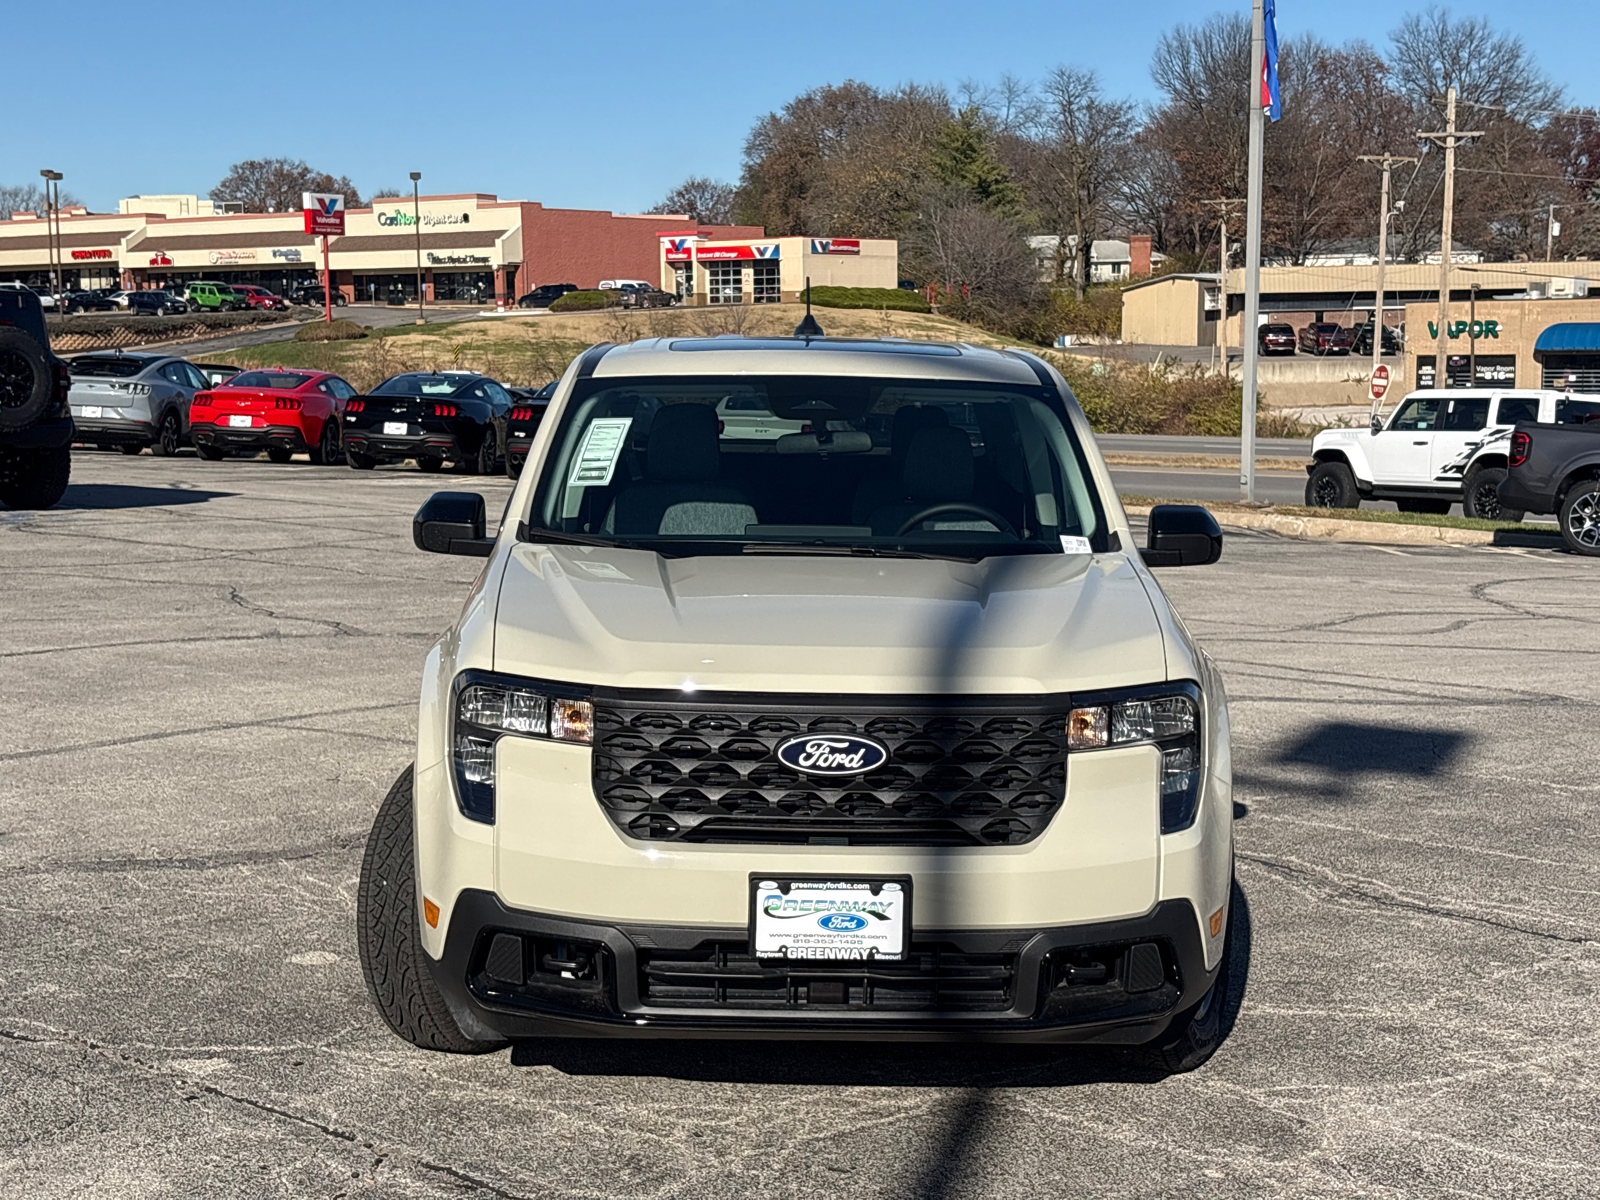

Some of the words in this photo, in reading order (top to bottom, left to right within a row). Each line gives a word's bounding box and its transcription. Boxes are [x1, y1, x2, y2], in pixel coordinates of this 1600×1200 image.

[798, 740, 864, 768] Ford
[790, 882, 870, 890] greenwayfordkc.com
[763, 894, 894, 914] GREENWAY
[828, 915, 858, 929] Ford
[768, 932, 888, 940] www.greenwayfordkc.com
[756, 951, 784, 959] Raytown
[786, 947, 871, 960] GREENWAY
